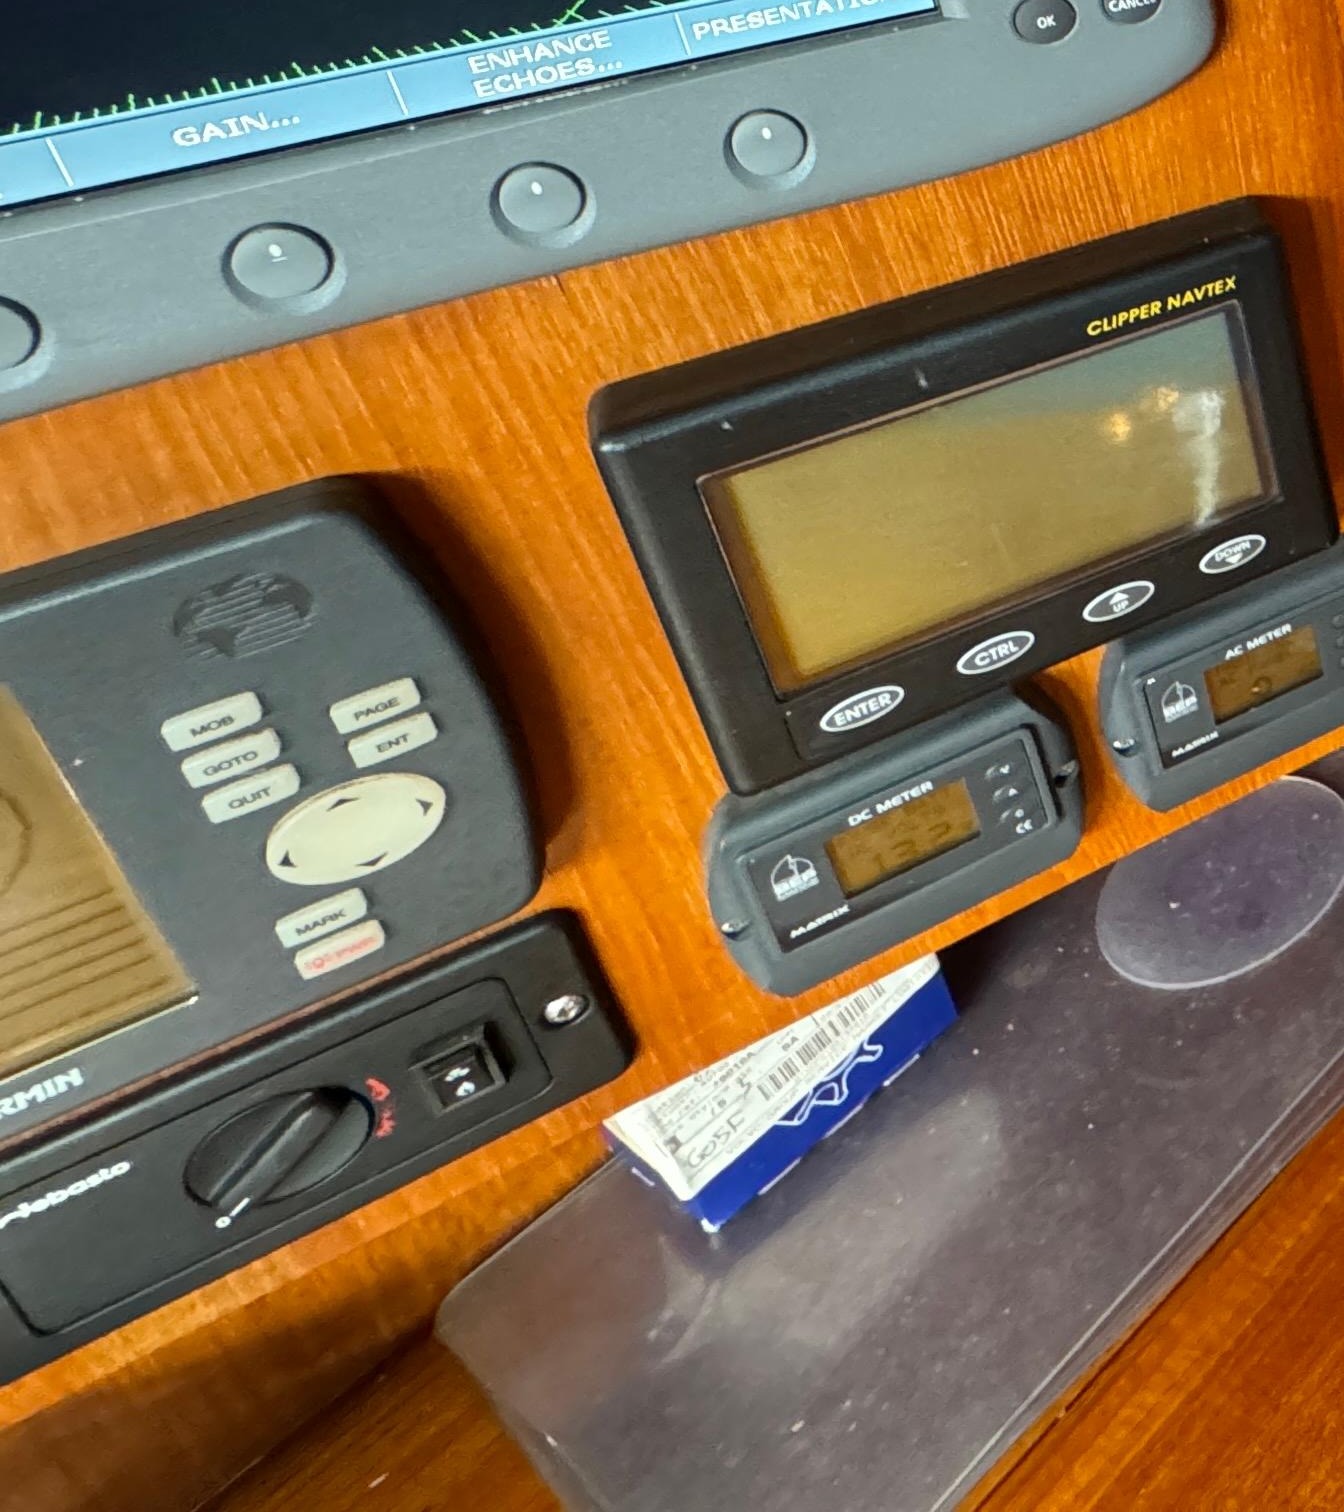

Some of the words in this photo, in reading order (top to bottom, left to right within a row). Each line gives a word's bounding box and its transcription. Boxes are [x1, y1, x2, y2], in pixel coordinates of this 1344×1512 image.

[1036, 14, 1057, 29] OK
[467, 30, 613, 75] ENHANCE
[473, 60, 624, 99] ECHOES...
[170, 112, 300, 147] GAIN...
[1086, 297, 1163, 338] CLIPPER
[1166, 274, 1238, 317] NAVTEX
[1214, 540, 1252, 562] DOWN
[1112, 599, 1130, 613] UP
[973, 638, 1020, 669] CTRL
[1224, 646, 1245, 661] AC
[1246, 623, 1292, 651] METER
[353, 696, 401, 721] PAGE
[833, 693, 893, 727] ENTER
[188, 714, 236, 738] MOB
[375, 733, 411, 754] ENT
[203, 748, 258, 777] GOTO
[228, 786, 272, 810] QUIT
[848, 809, 874, 827] DC
[876, 780, 934, 813] METER
[295, 908, 347, 936] MARK
